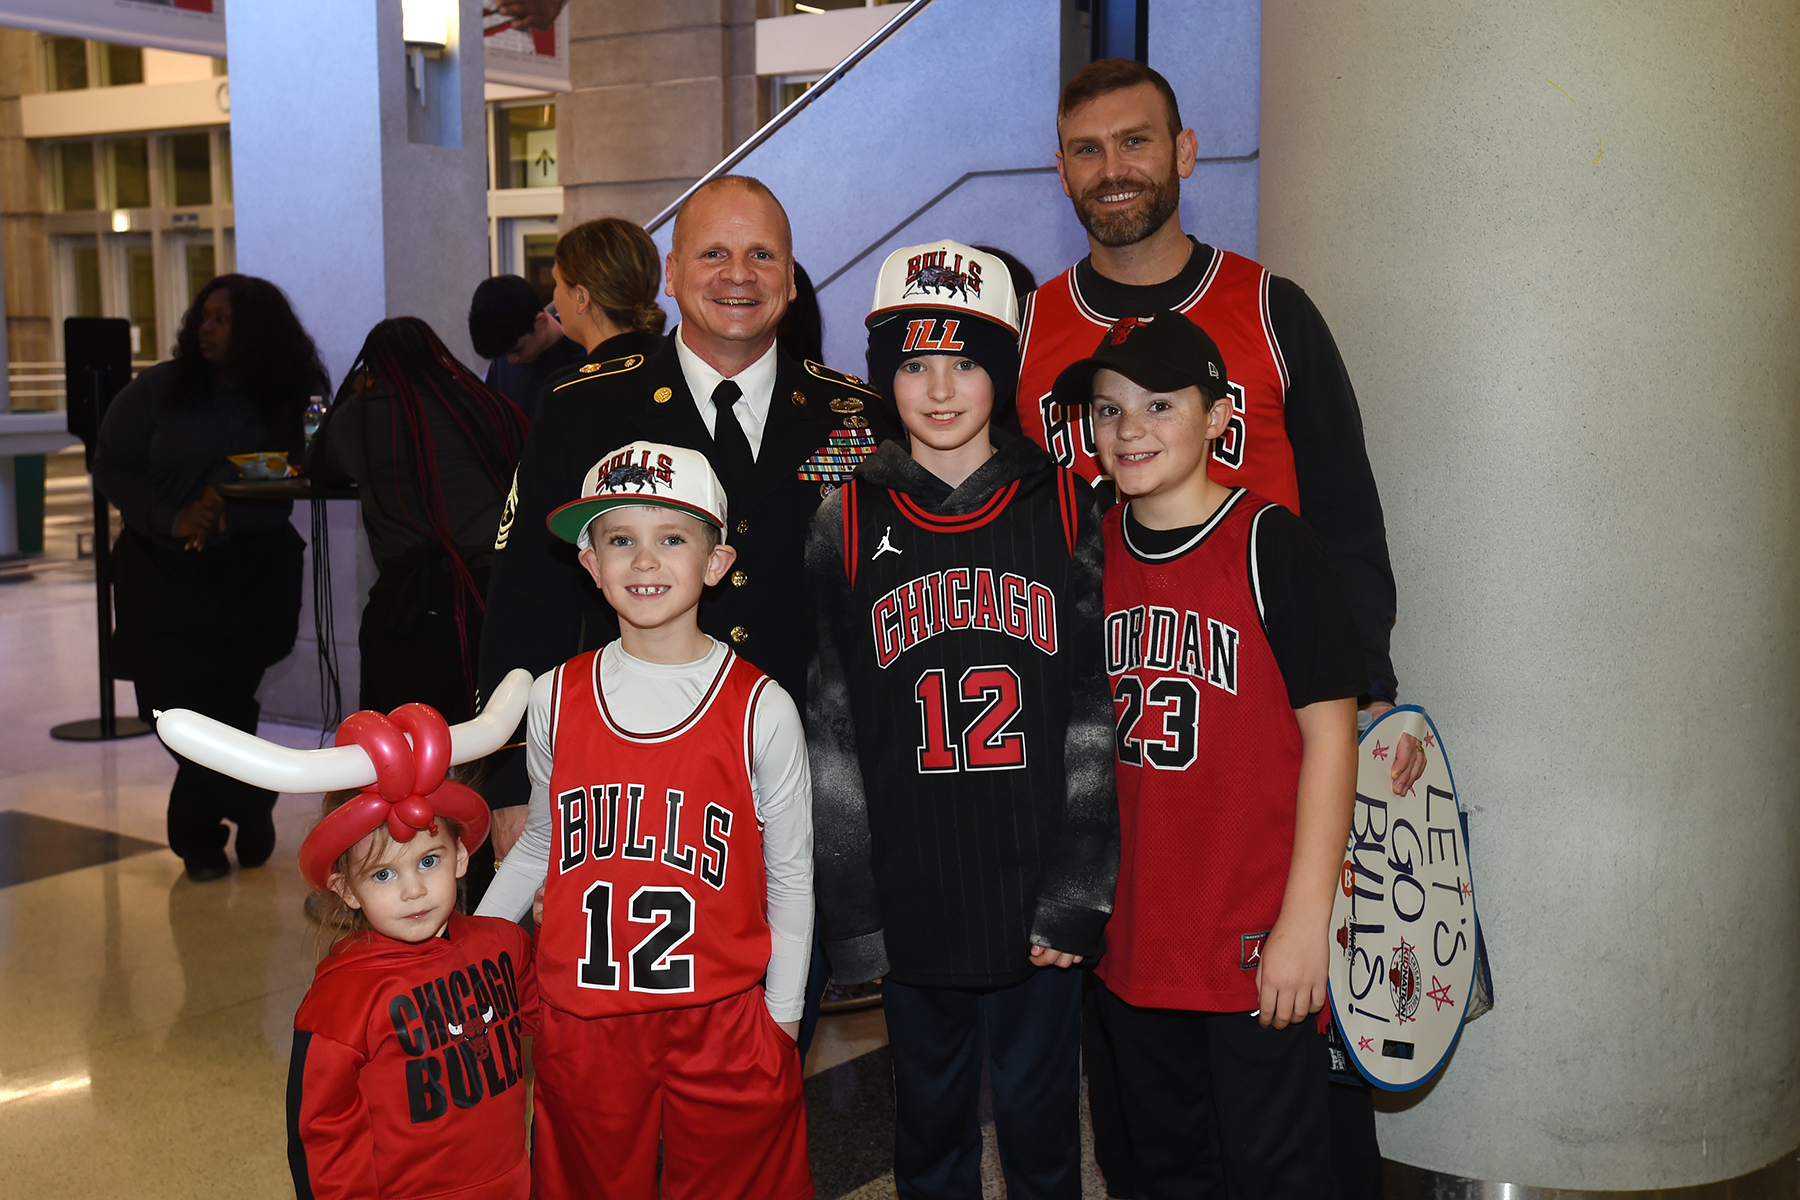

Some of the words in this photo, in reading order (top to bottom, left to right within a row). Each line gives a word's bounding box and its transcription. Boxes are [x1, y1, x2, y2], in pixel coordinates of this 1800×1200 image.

[902, 319, 965, 352] ILL
[871, 568, 1058, 669] CHICAGO
[1104, 604, 1239, 696] ORDAN
[915, 665, 1027, 774] 12
[1113, 675, 1200, 771] 23
[558, 783, 733, 891] BULLS
[1387, 818, 1426, 923] GO
[1426, 784, 1467, 966] LET'S
[577, 880, 696, 994] 12
[389, 951, 520, 1057] CHICAGO
[405, 1015, 524, 1124] BULLS
